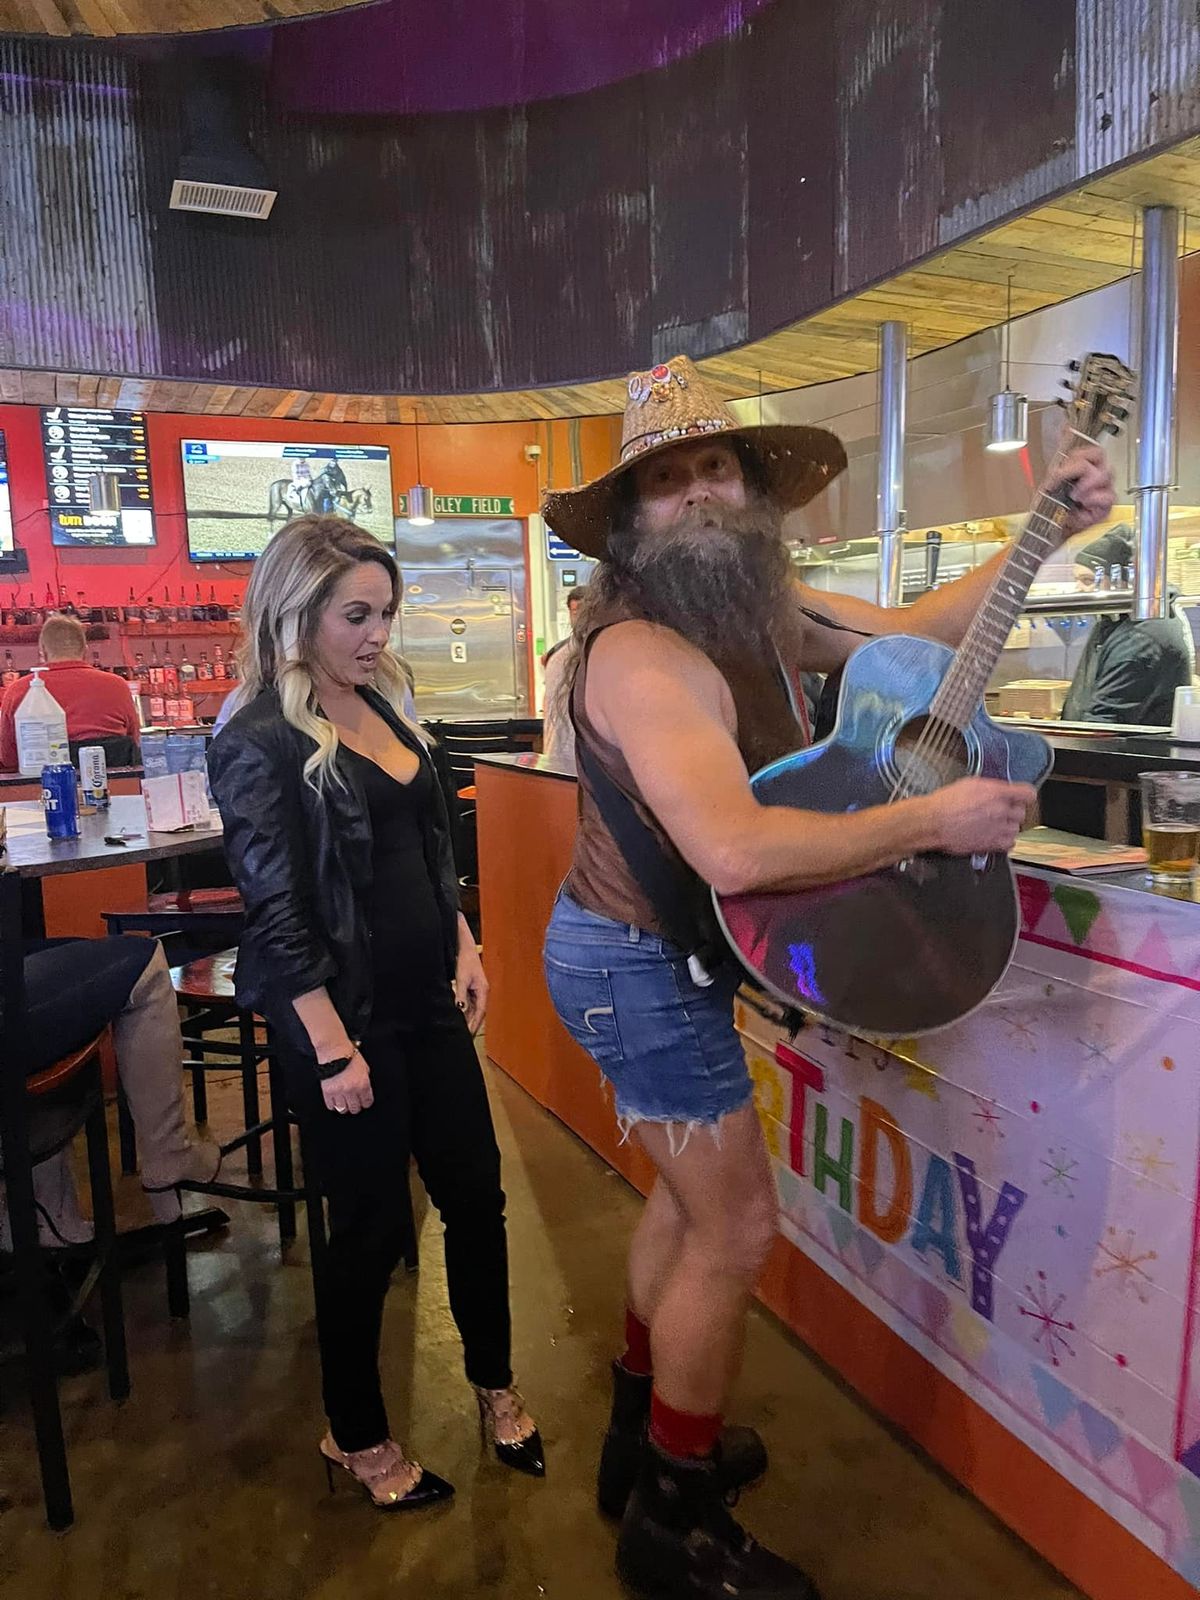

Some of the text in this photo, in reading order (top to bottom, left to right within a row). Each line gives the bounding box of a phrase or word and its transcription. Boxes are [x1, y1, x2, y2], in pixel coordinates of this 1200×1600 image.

[434, 497, 501, 513] GLEY FIELD
[92, 754, 103, 788] Corona
[752, 1041, 1028, 1323] RTHDAY
